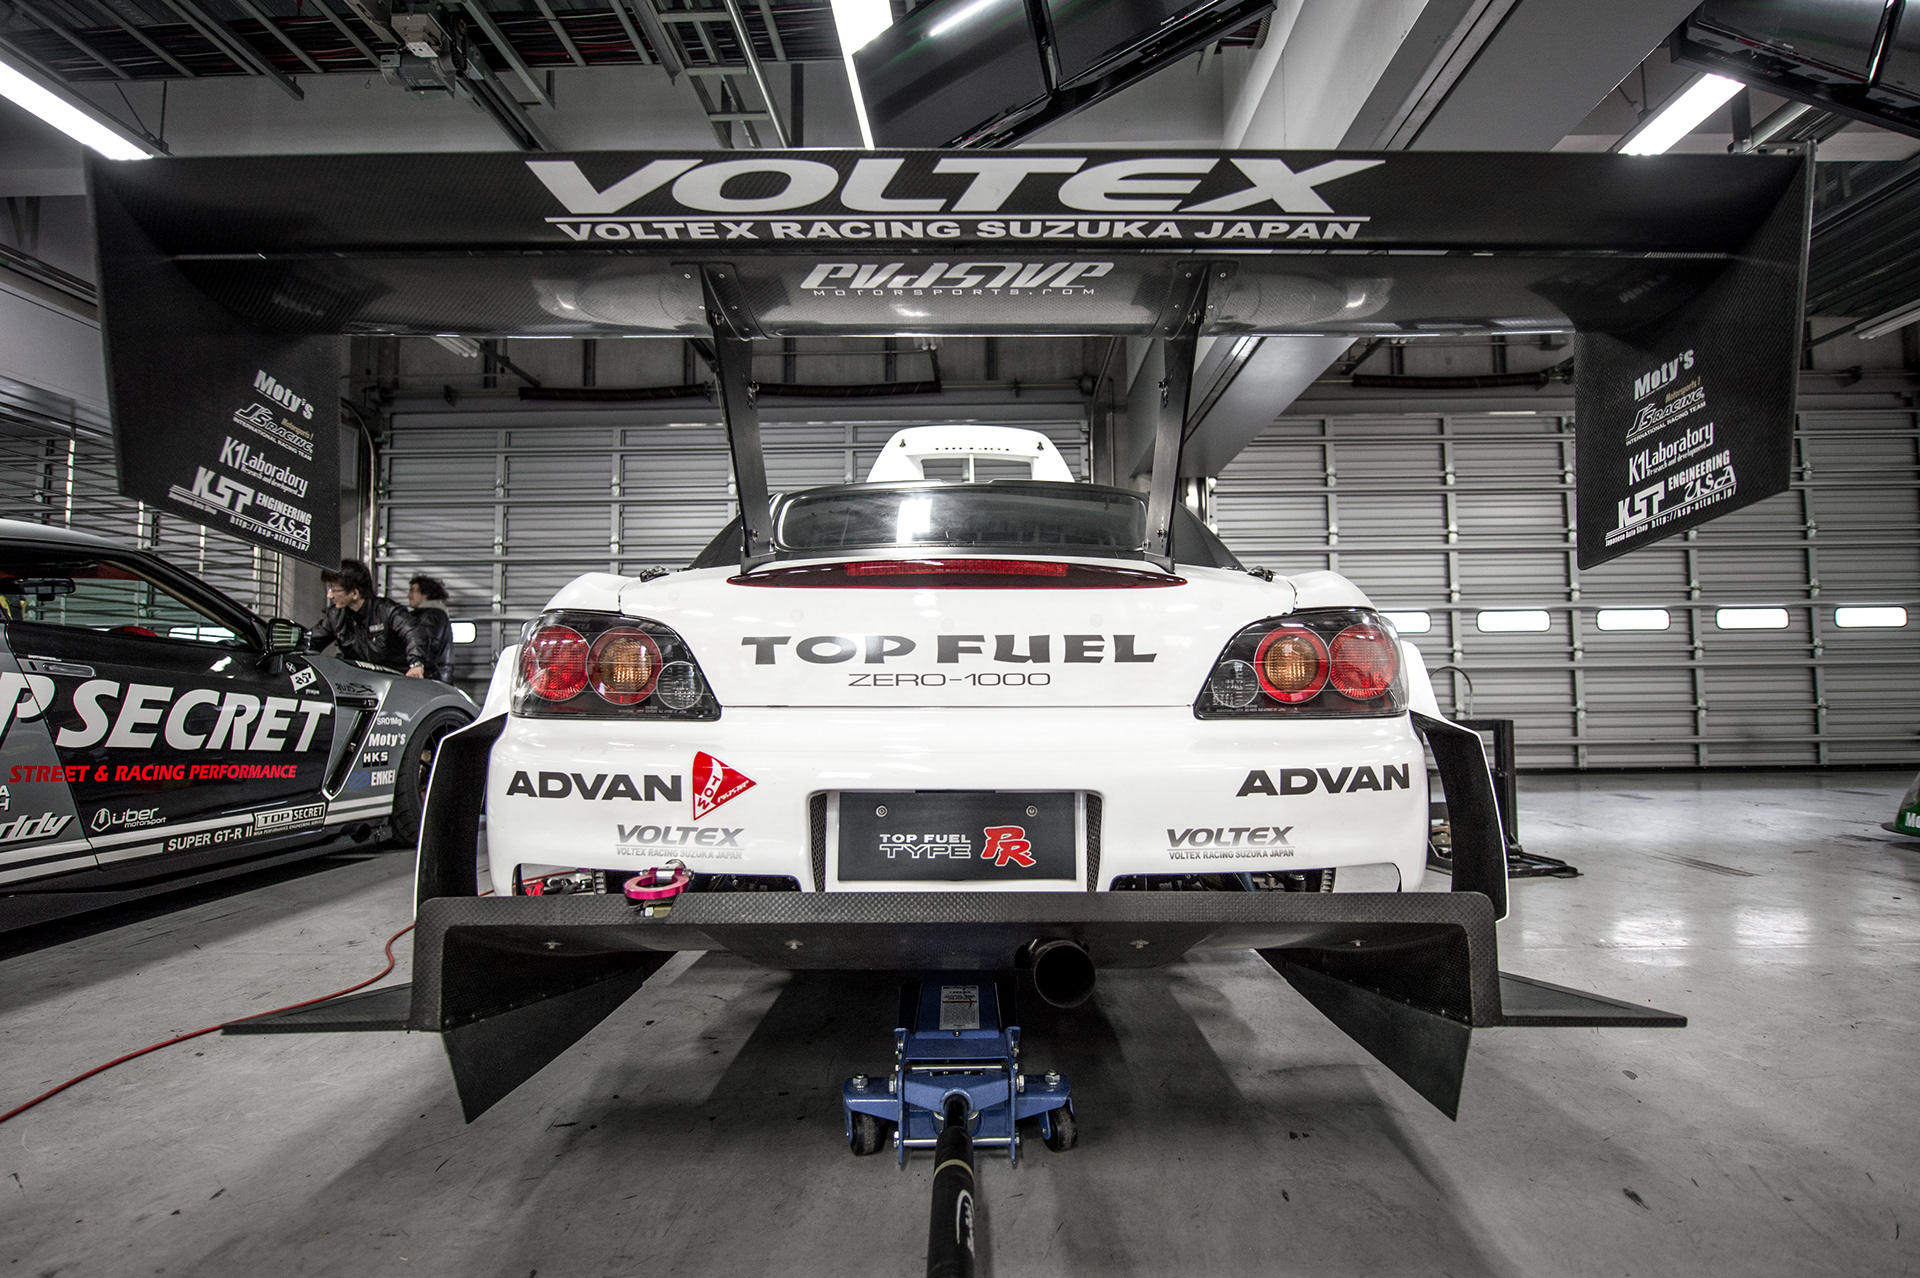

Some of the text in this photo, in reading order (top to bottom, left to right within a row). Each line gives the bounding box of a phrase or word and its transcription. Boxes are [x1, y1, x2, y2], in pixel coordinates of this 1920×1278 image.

[524, 157, 1387, 214] VOLTEX
[555, 221, 1360, 241] VOLTEX RACING SUZUKA JAPAN
[1634, 349, 1695, 400] Moty's
[253, 369, 315, 420] Moty's
[1668, 450, 1730, 491] ENGINEERING
[255, 492, 312, 526] ENGINEERING
[741, 634, 1157, 665] TOP FUEL
[848, 673, 1051, 687] ZERO-1000
[55, 679, 333, 752] SECRET
[368, 733, 406, 747] Moty's
[363, 752, 388, 763] HKS
[8, 765, 297, 782] STREET & RACING PERFORMANCE
[371, 770, 396, 786] ENKEI
[1235, 763, 1410, 797] ADVAN
[506, 771, 682, 802] ADVAN
[697, 775, 721, 810] TOW
[293, 806, 323, 820] SECRET
[168, 833, 211, 851] SUPER
[214, 826, 243, 843] GT-R
[617, 824, 745, 847] VOLTEX
[880, 834, 971, 843] TOP FUEL
[1167, 826, 1294, 847] VOLTEX
[616, 847, 742, 859] VOLTEX RACING SUZUKA JAPAN
[880, 844, 971, 859] TYPE
[1169, 849, 1294, 860] VOLTEX RACING SUZUKA JAPAN
